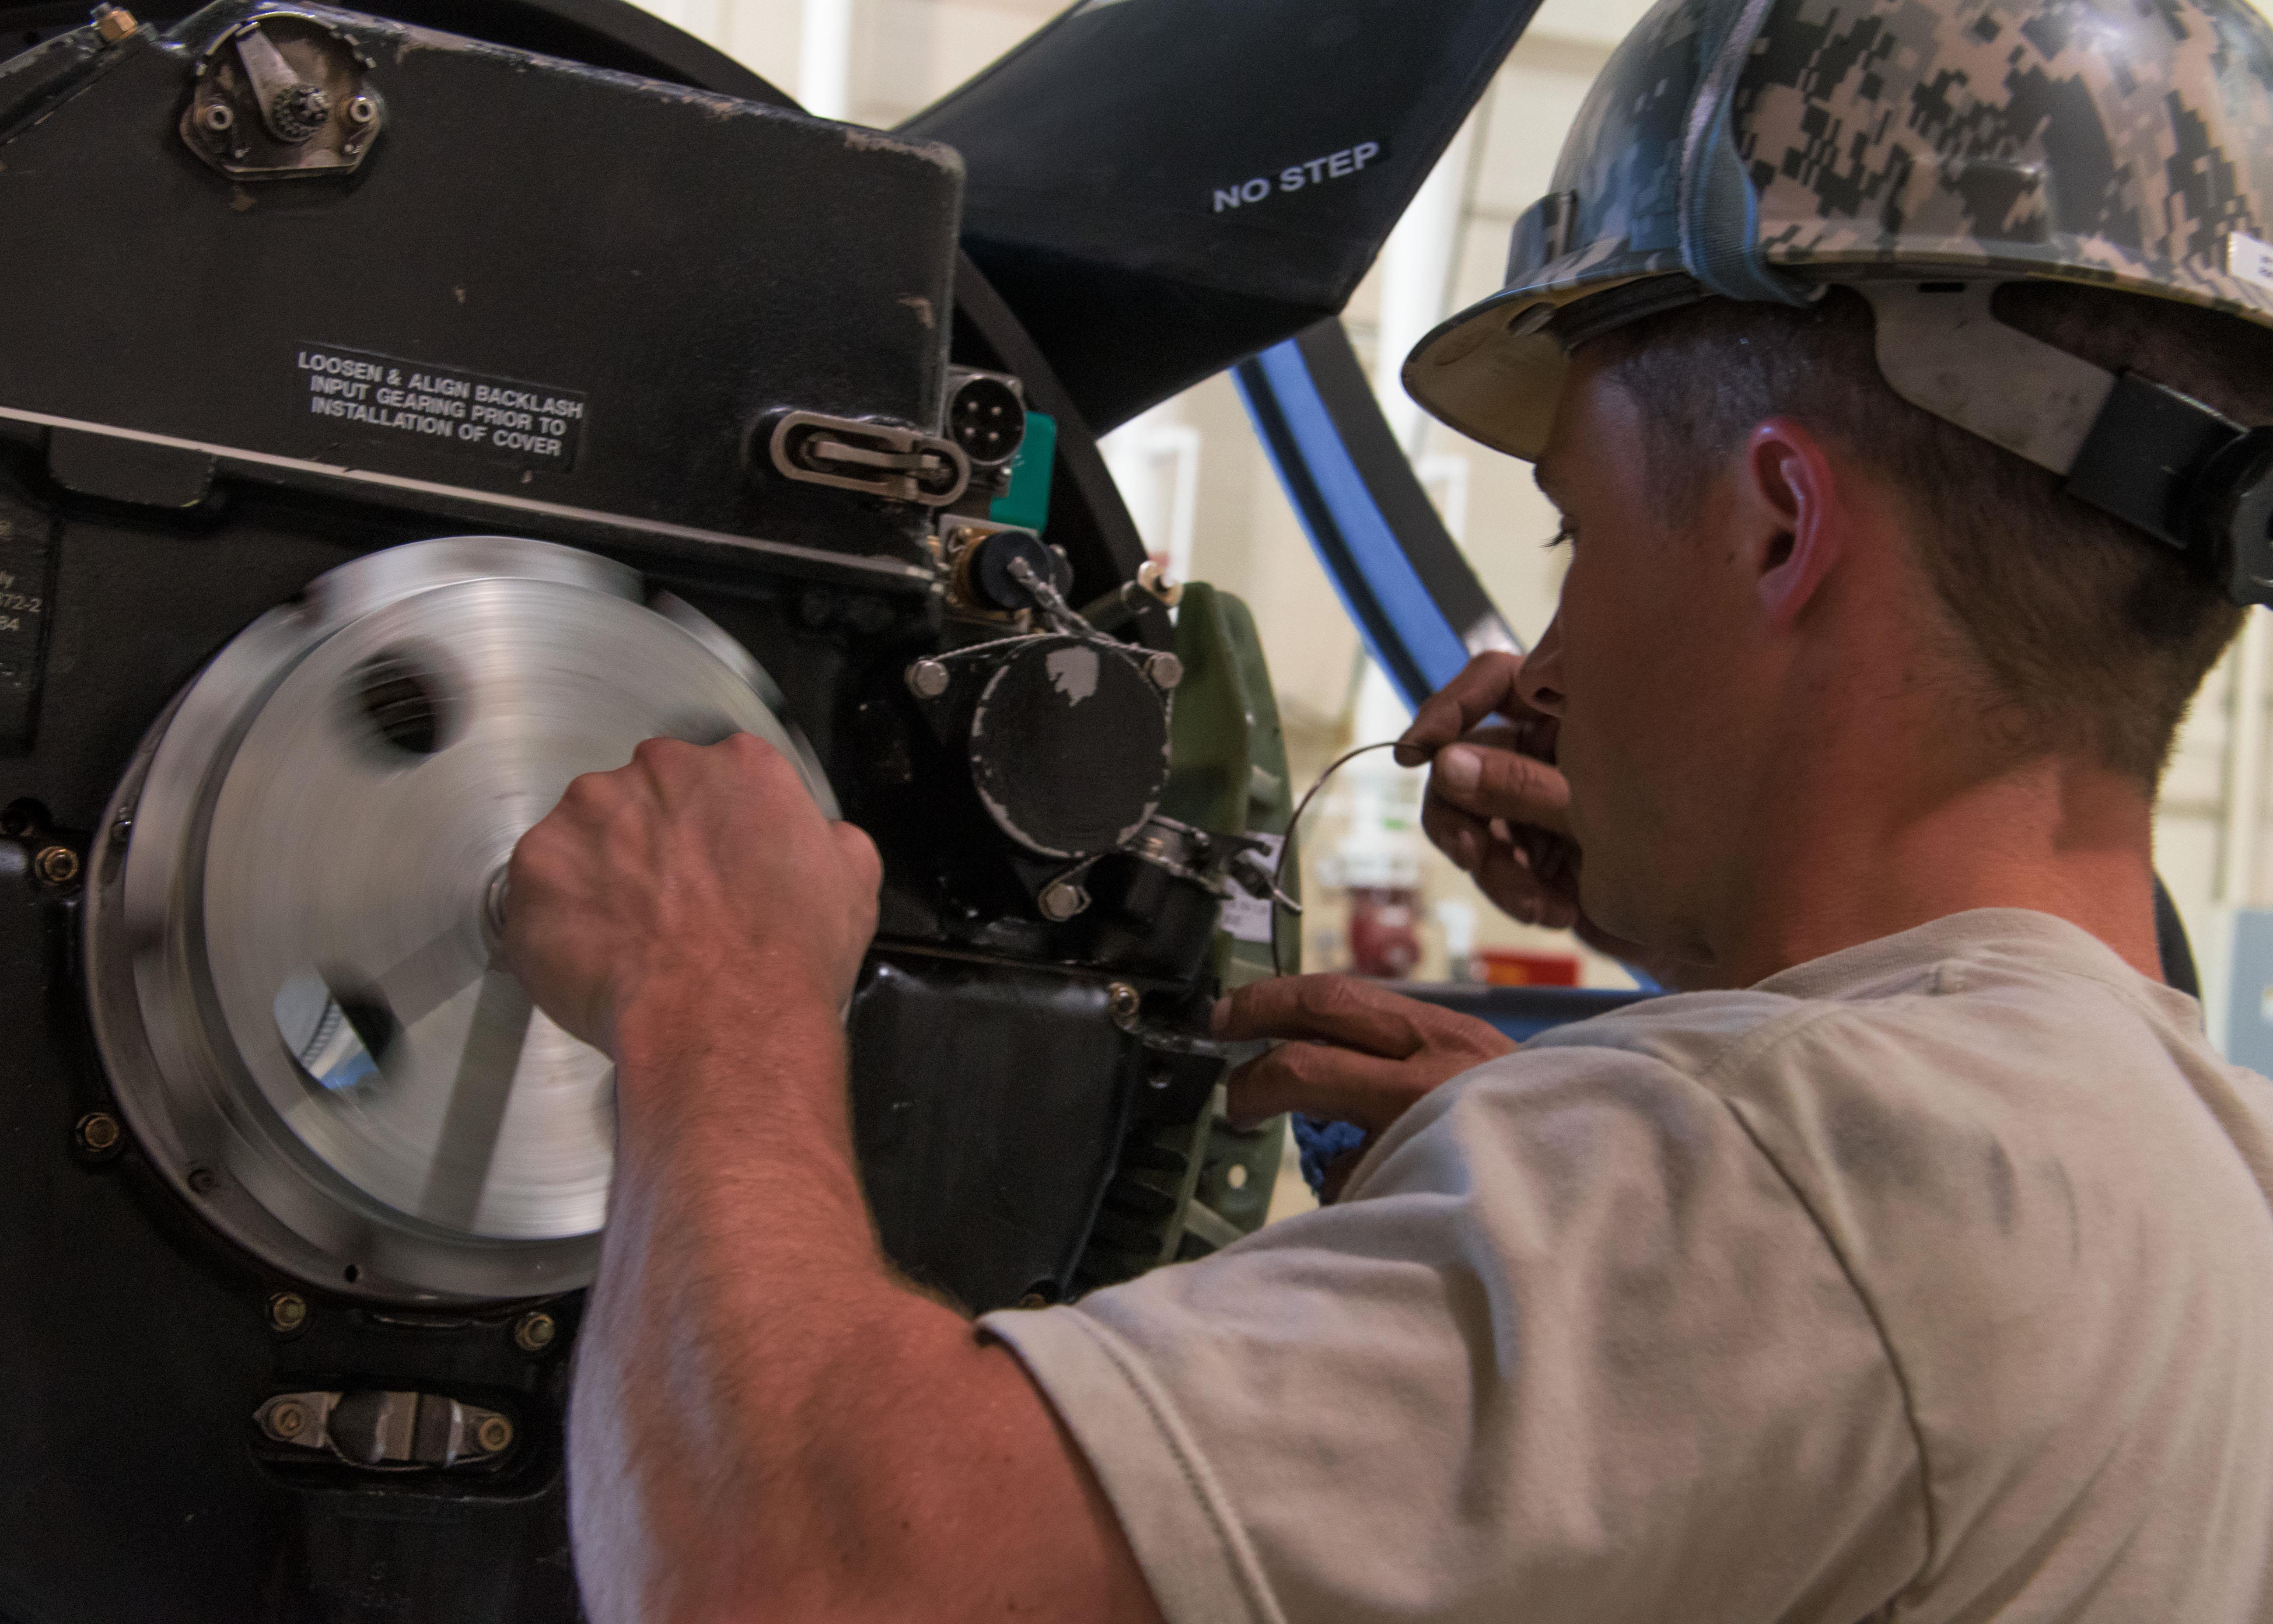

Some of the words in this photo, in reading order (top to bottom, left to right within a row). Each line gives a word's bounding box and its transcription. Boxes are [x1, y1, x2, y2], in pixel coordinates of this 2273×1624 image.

[1214, 178, 1270, 213] NO
[1280, 141, 1379, 192] STEP
[298, 352, 383, 382] LOOSEN
[387, 369, 402, 386] &
[409, 374, 470, 398] ALIGN
[475, 385, 583, 419] BACKLASH
[311, 375, 371, 399] INPUT
[376, 388, 465, 418] GEARING
[471, 405, 533, 430] PRIOR
[539, 417, 567, 436] TO
[311, 397, 453, 437] INSTALLATION
[458, 424, 488, 441] OF
[493, 430, 562, 456] COVER
